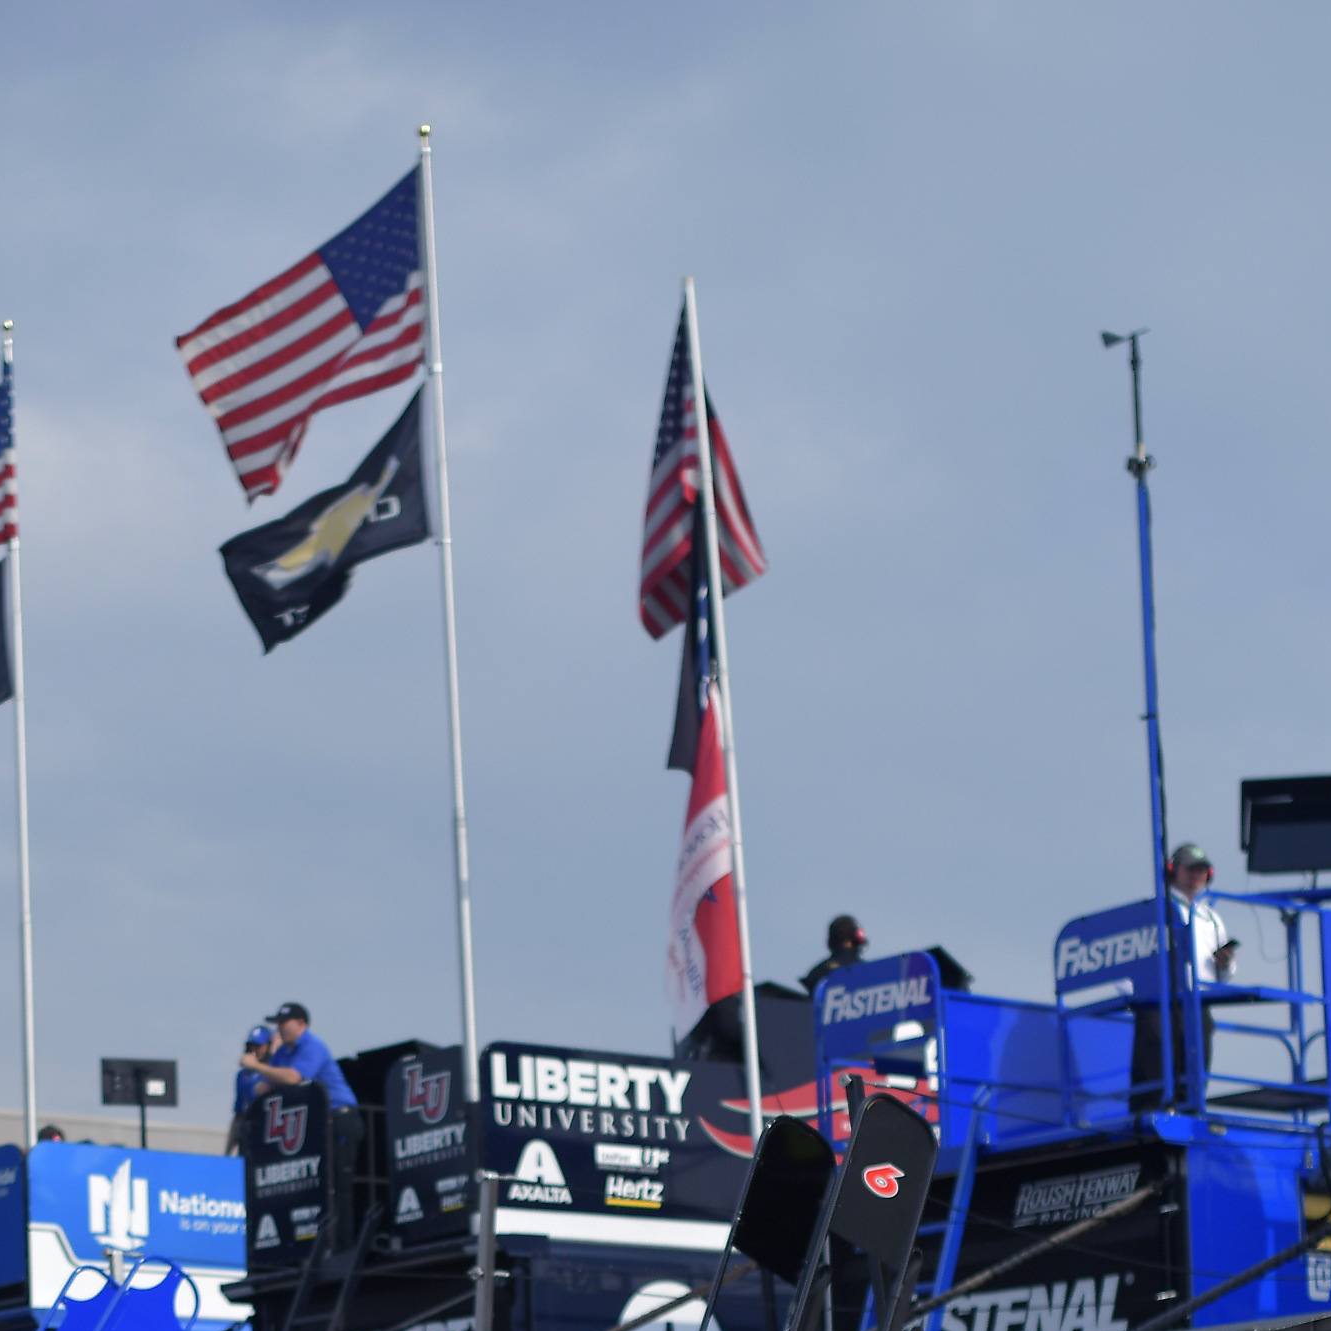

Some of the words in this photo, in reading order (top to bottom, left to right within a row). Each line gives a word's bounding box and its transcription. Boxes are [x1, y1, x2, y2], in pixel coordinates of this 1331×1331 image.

[1056, 922, 1161, 981] FASTENA
[822, 975, 933, 1026] FASTENAL
[402, 1062, 452, 1125] LU
[489, 1052, 692, 1115] LIBERTY
[394, 1122, 467, 1160] LIBERTY
[493, 1102, 691, 1142] UNIVERSITY
[254, 1155, 321, 1188] LIBERTY
[606, 1175, 665, 1202] Hertz
[862, 1162, 905, 1199] 6
[1073, 1170, 1141, 1207] FENWAY
[508, 1182, 573, 1205] AXALTA
